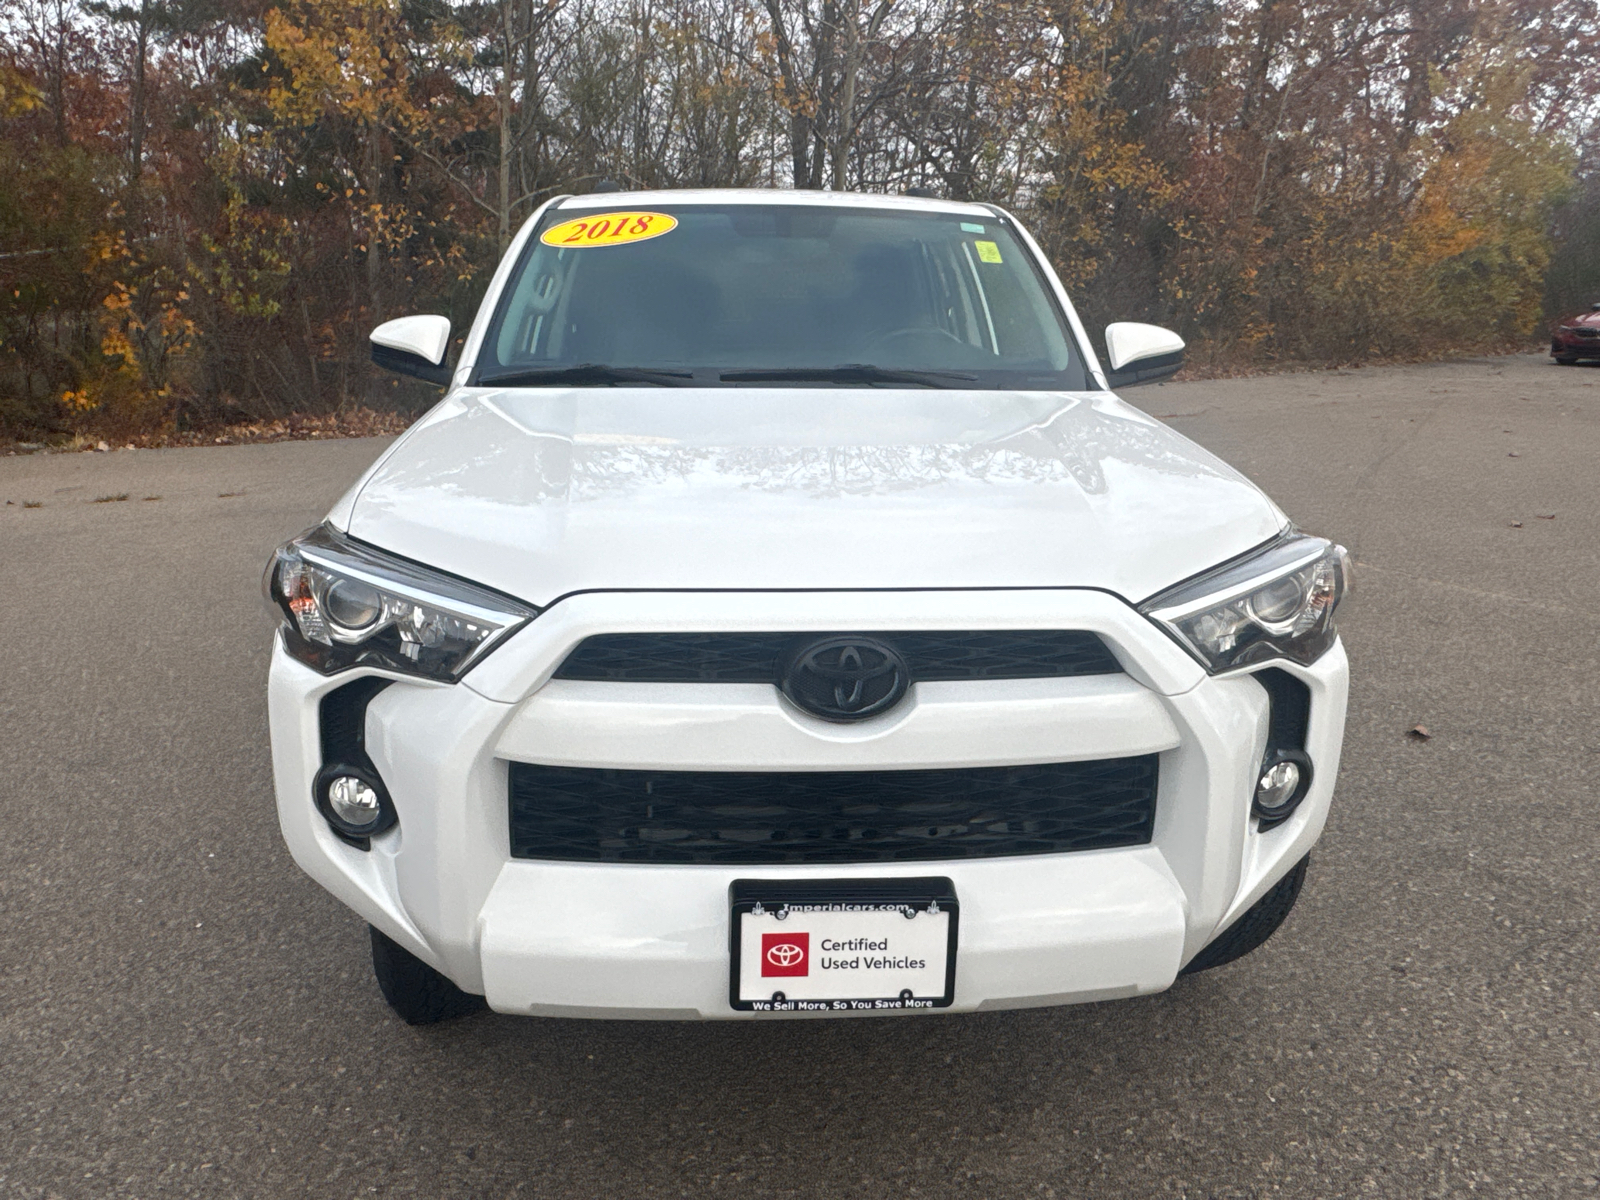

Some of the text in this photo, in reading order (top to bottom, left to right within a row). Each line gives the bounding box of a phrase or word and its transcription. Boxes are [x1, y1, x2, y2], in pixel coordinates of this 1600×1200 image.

[562, 215, 654, 243] 2018
[820, 937, 888, 951] Certified
[820, 956, 926, 970] Used Vehicles
[752, 999, 933, 1011] We Sell More, So You Save More
